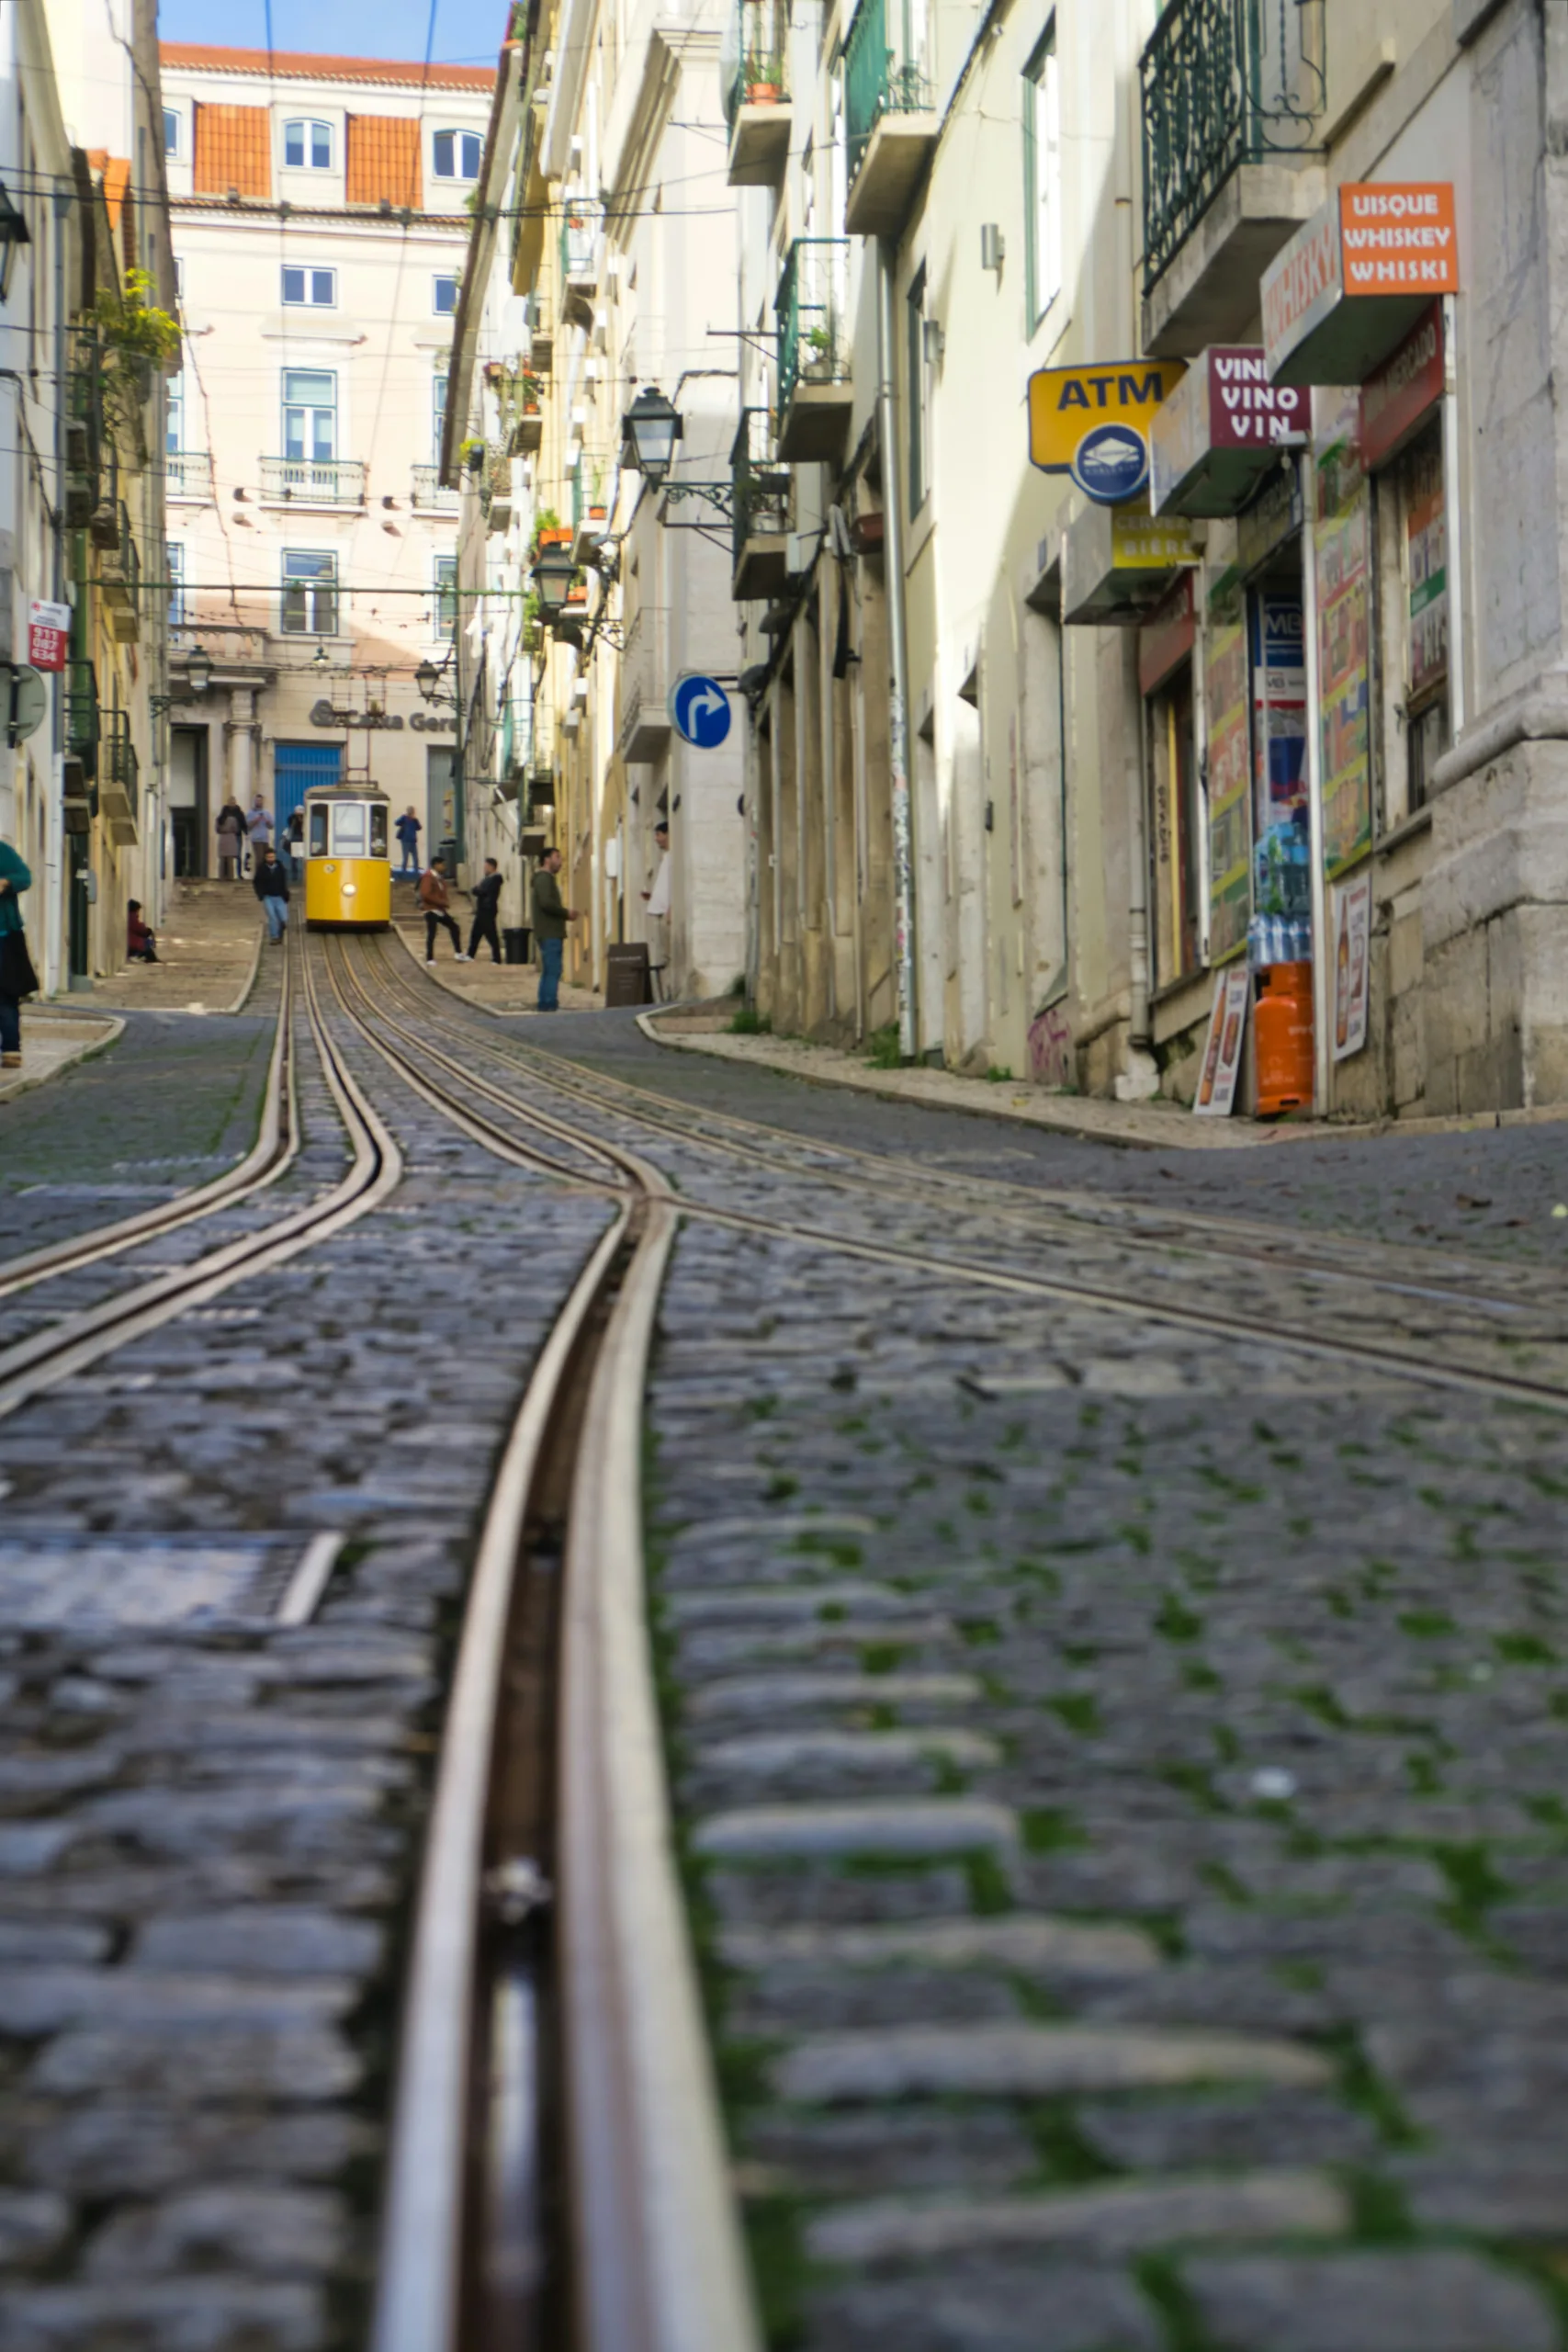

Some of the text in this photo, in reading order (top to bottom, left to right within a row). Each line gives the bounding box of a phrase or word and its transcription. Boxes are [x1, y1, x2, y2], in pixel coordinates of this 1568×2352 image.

[1352, 194, 1438, 219] UISQUE
[1344, 227, 1450, 248] WHISKEY
[1349, 260, 1448, 281] WHISKI
[1265, 223, 1336, 351] WHISKY
[1056, 372, 1164, 411] ATM
[1221, 386, 1299, 411] VINO
[1230, 414, 1290, 438] VIN
[1115, 514, 1193, 531] CERVEZ
[33, 627, 59, 641] 911
